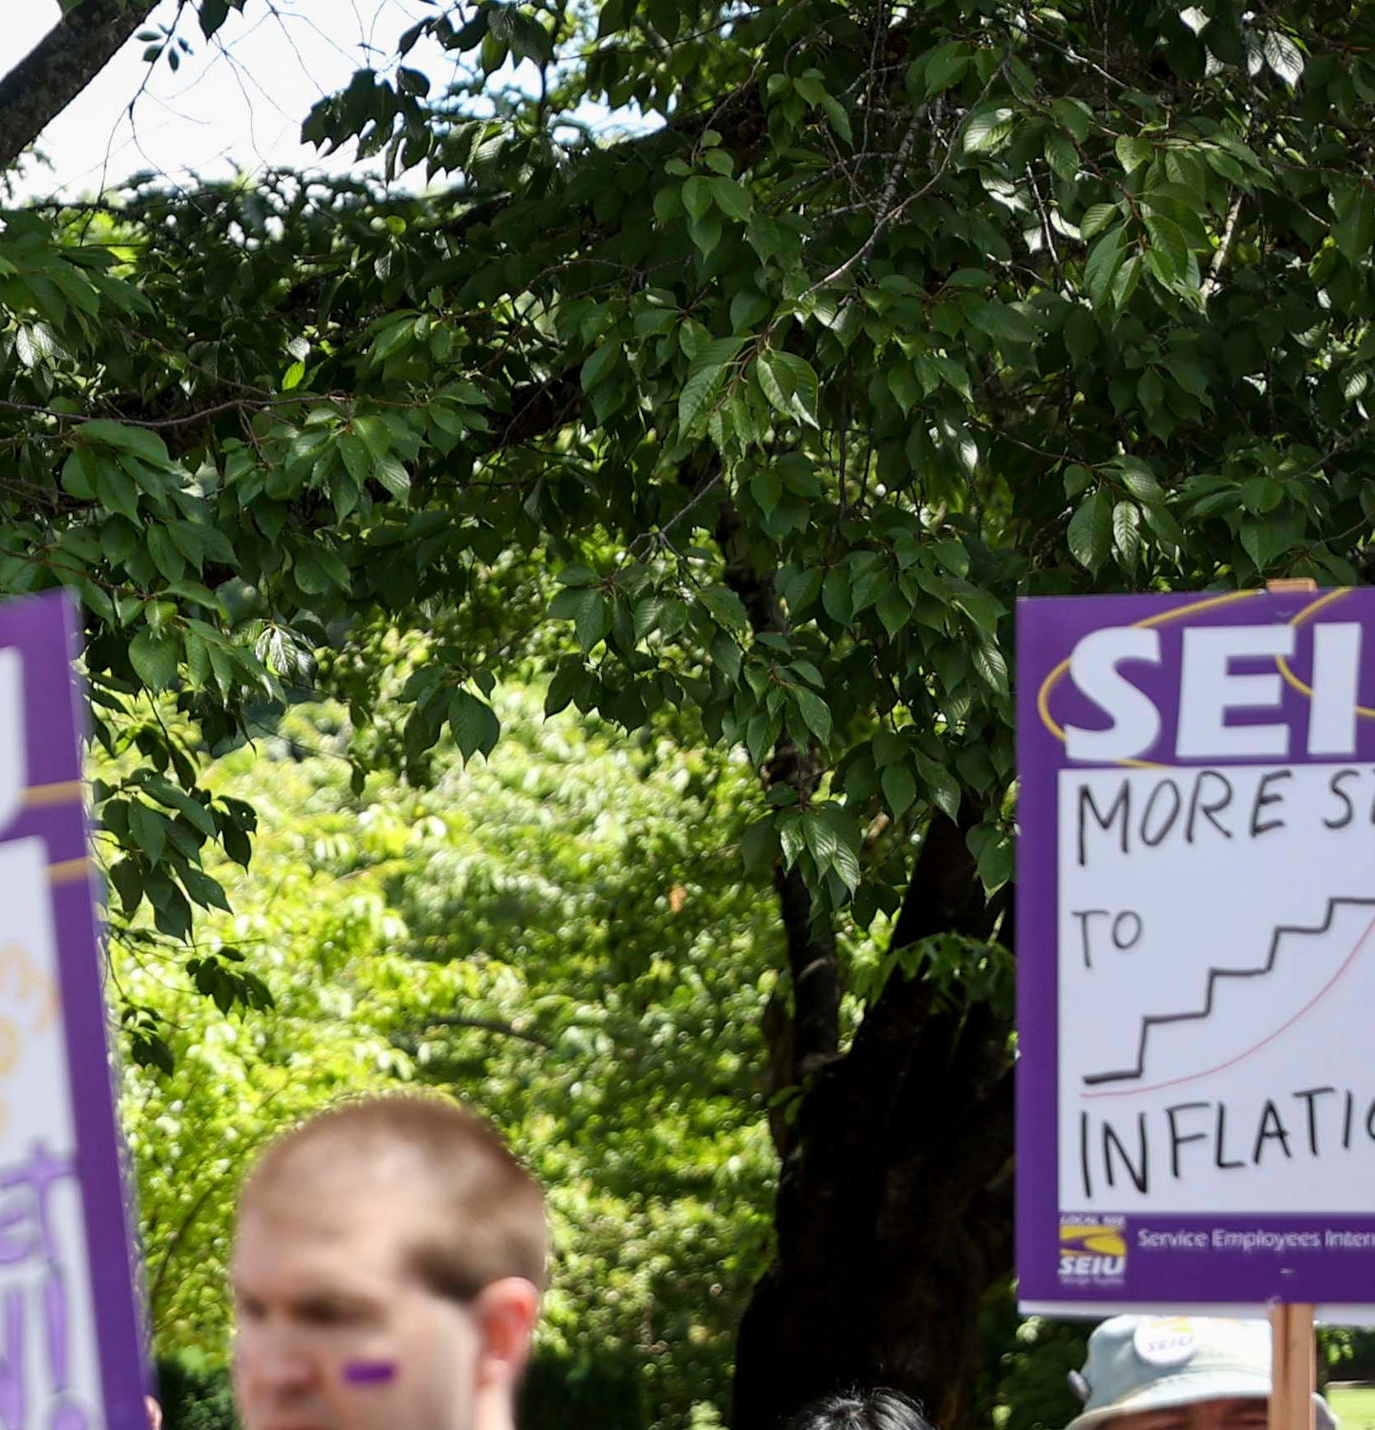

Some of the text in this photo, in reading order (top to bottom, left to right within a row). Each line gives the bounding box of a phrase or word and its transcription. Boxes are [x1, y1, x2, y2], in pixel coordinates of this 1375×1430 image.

[1064, 621, 1361, 762] SEI
[1076, 768, 1294, 867] MORE
[1072, 910, 1143, 969] TO
[1057, 1256, 1126, 1275] SEIU
[1137, 1227, 1209, 1248] Service
[1212, 1228, 1321, 1252] Employees
